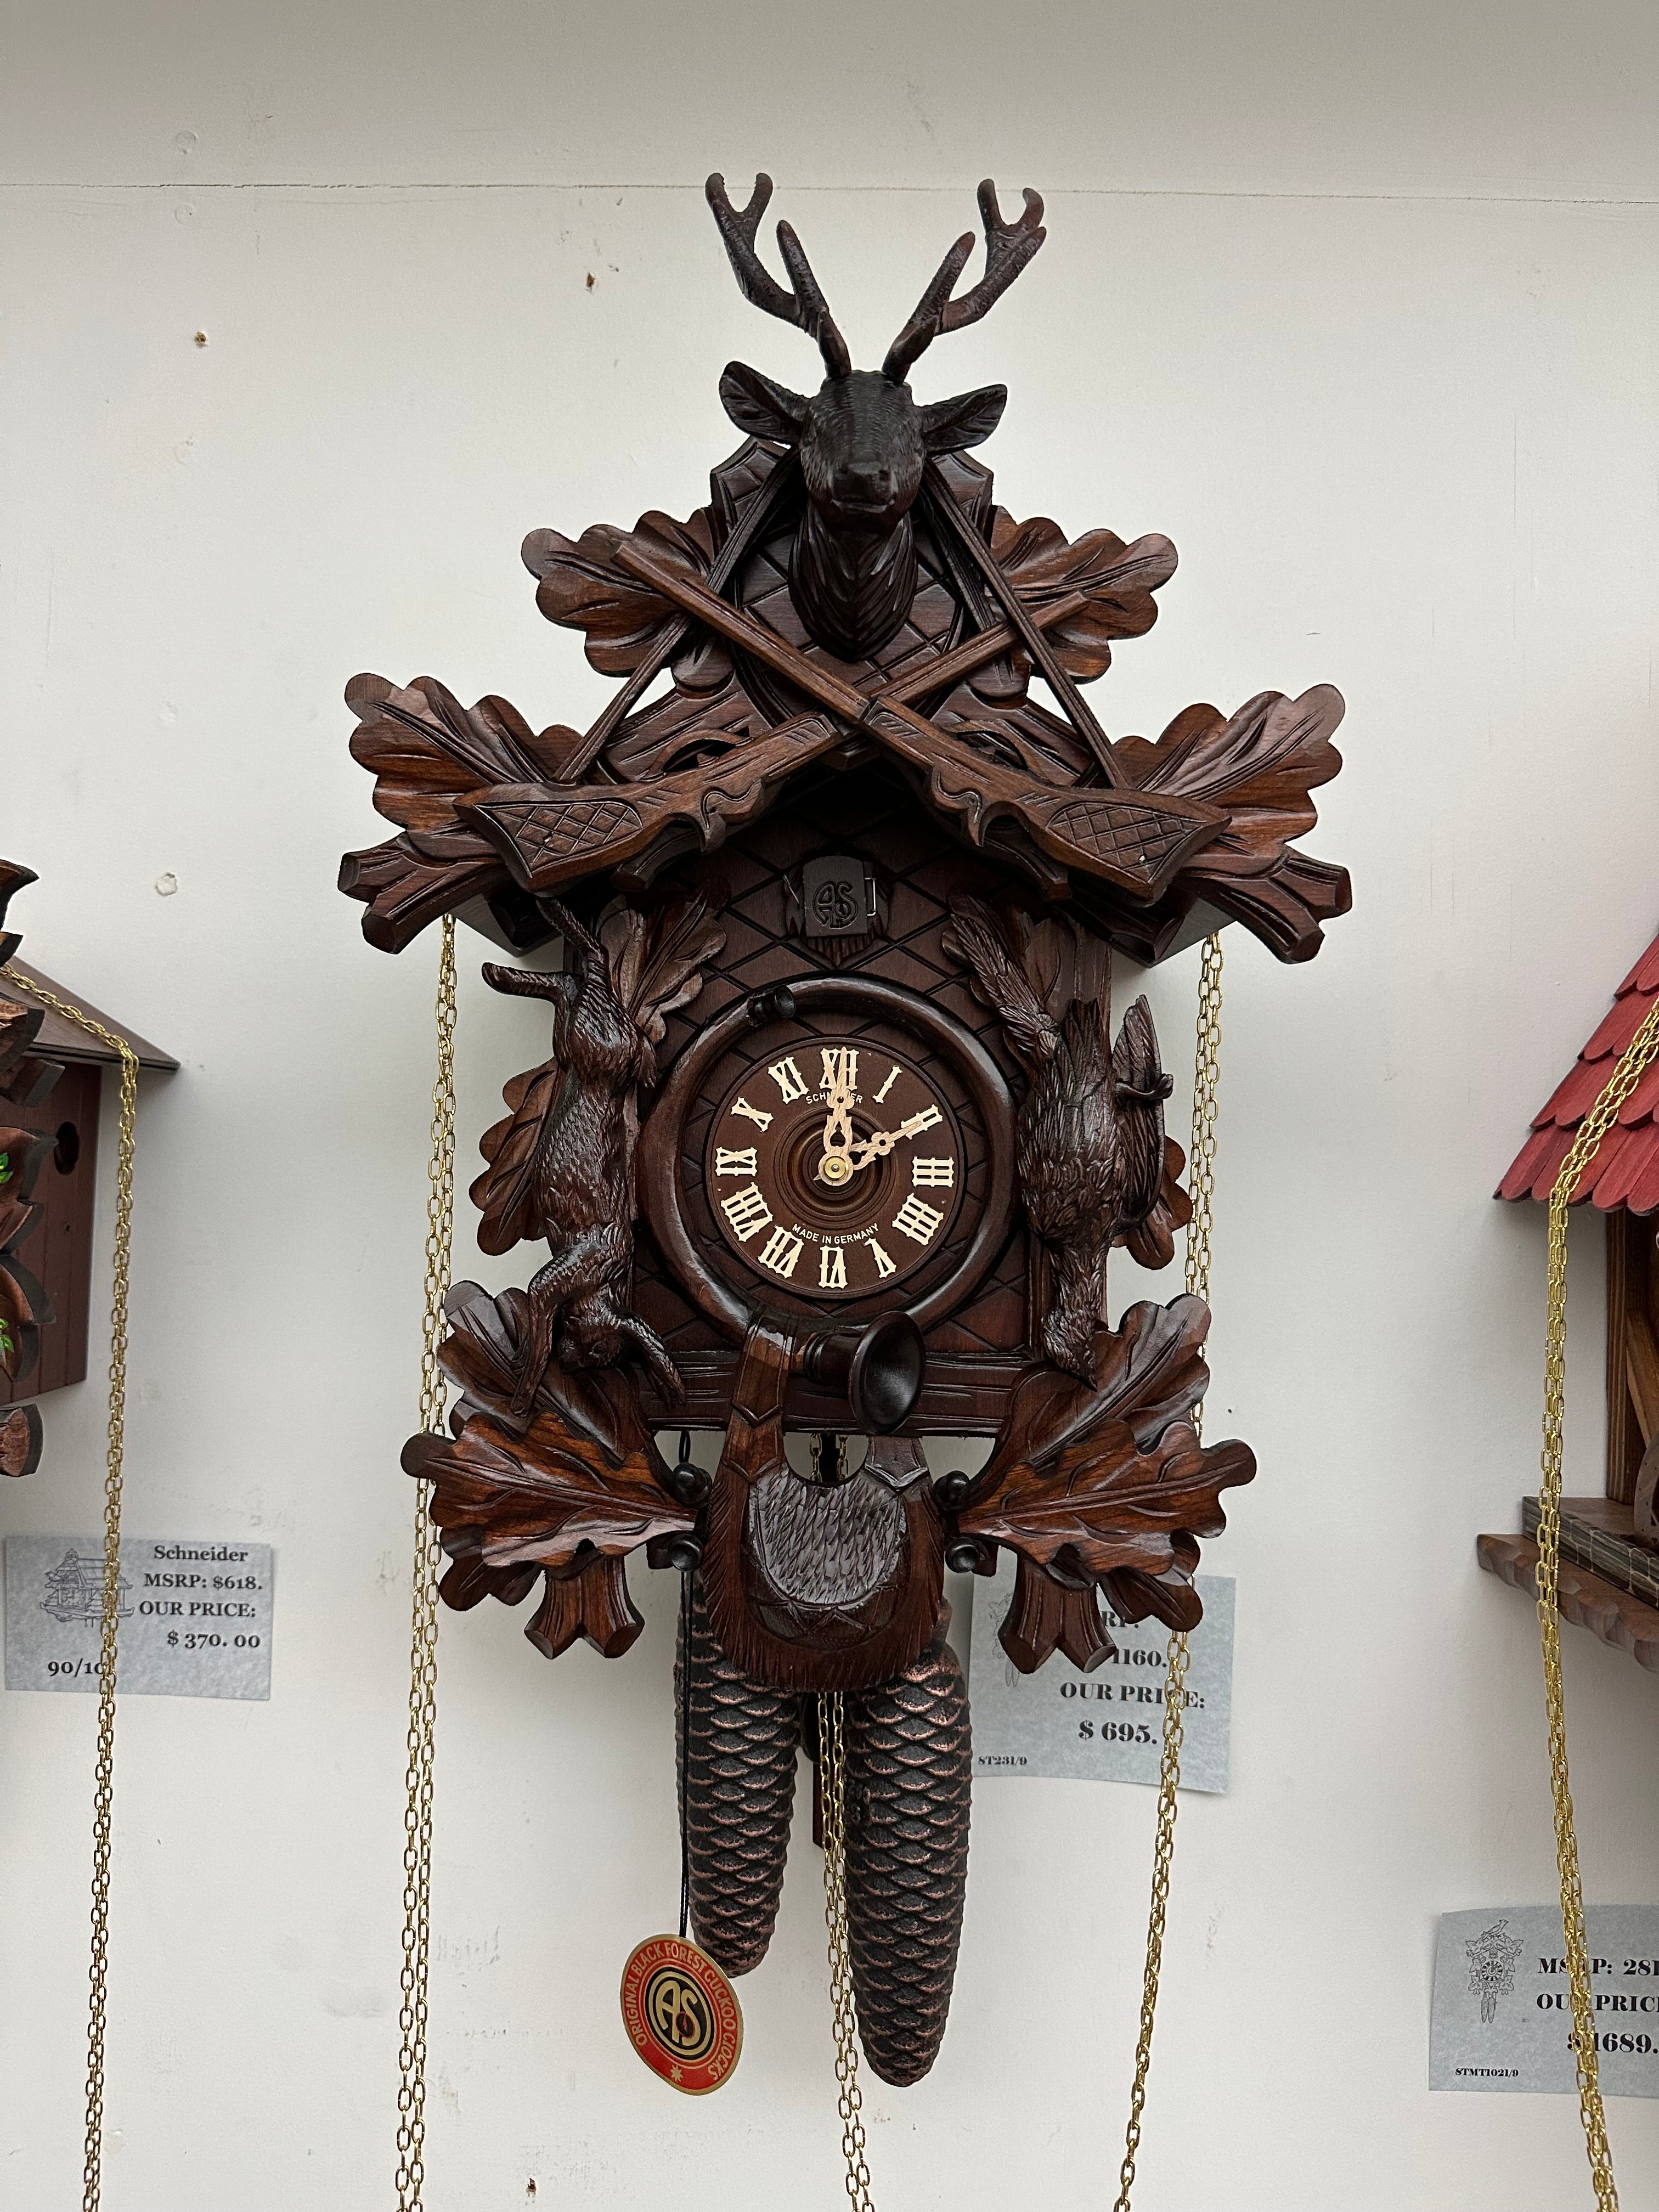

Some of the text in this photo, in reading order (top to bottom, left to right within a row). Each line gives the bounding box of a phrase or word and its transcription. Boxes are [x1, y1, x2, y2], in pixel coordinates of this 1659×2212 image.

[768, 1057, 809, 1104] XI
[731, 1097, 774, 1133] X
[912, 1156, 955, 1188] III
[792, 1223, 878, 1244] MADE IN GERMANY
[864, 1238, 896, 1278] V
[154, 1545, 249, 1562] Schneider
[144, 1573, 263, 1590] MSRP: $618.
[139, 1601, 256, 1618] OUR PRICE:
[1060, 1682, 1113, 1700] OUR
[1101, 1722, 1158, 1745] 695.
[978, 1756, 1028, 1766] ST231/9
[630, 1943, 665, 1978] BLACK
[664, 1942, 708, 1973] FOREST
[1538, 1957, 1612, 1975] MSP:
[624, 1975, 648, 2046] ORIGINAL
[704, 1968, 736, 2030] CUCKOO
[1595, 1995, 1659, 2013] PRIC
